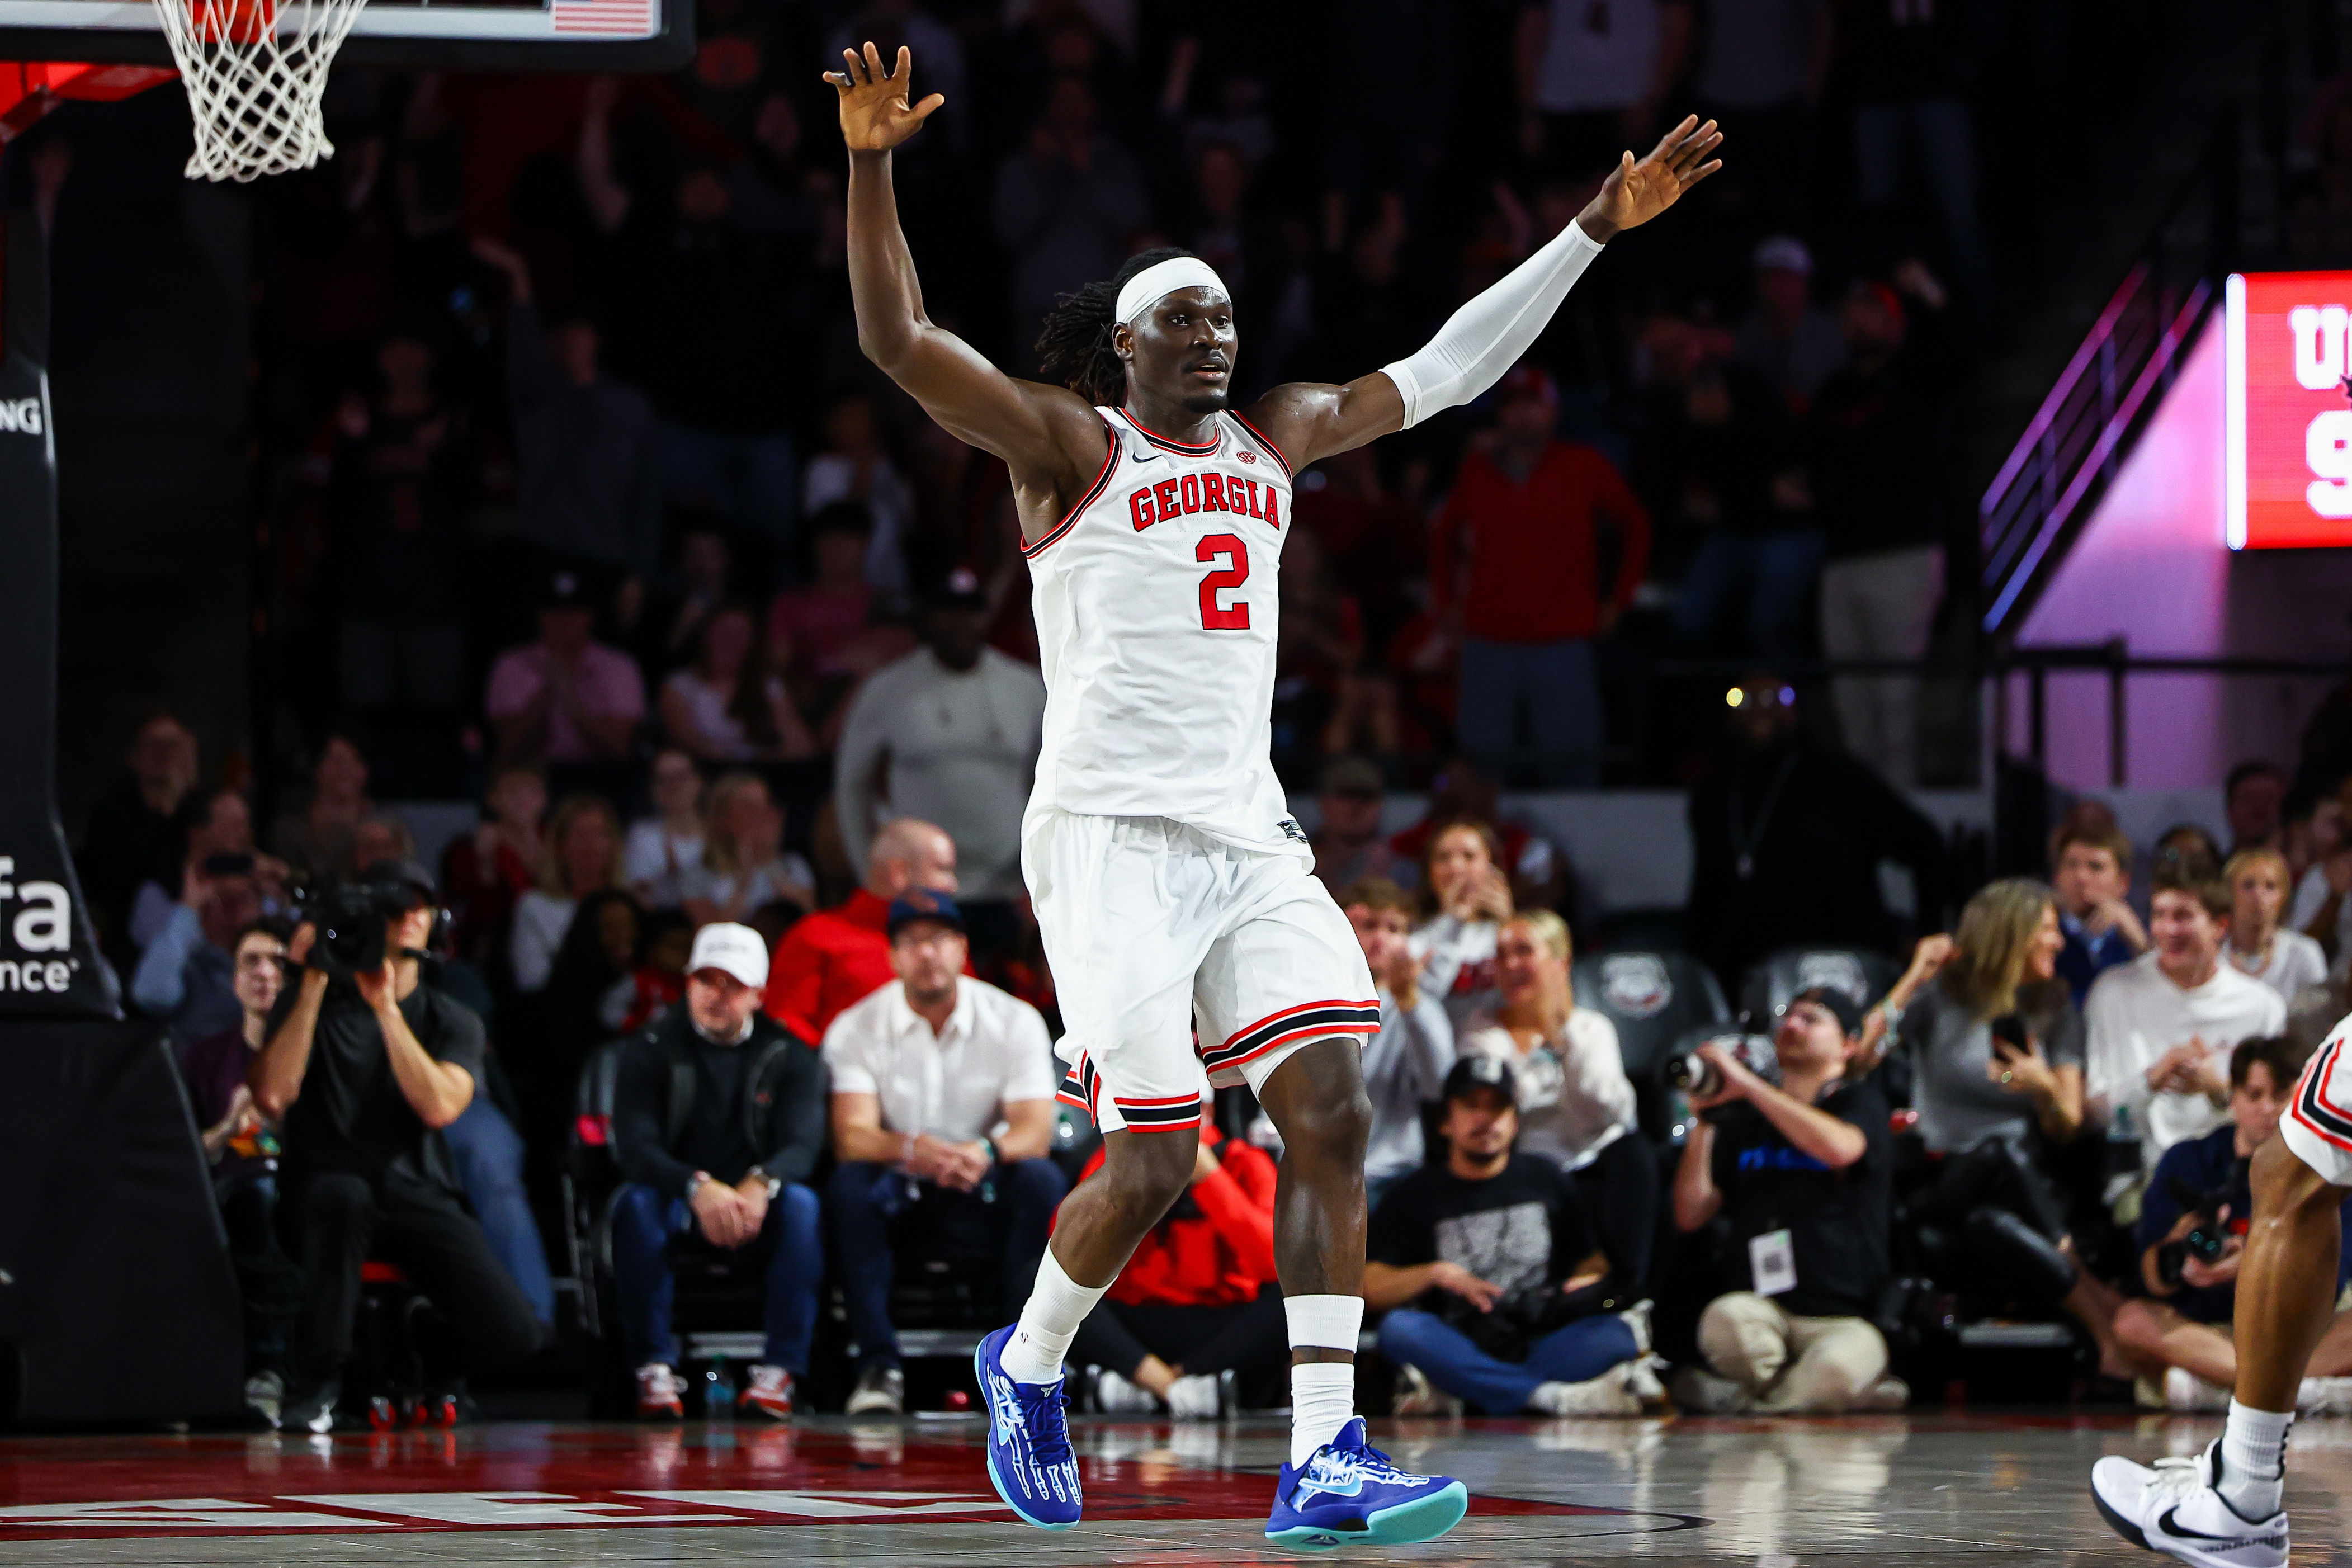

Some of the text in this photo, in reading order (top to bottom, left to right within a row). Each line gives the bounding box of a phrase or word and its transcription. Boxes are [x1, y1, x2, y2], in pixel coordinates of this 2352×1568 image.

[2287, 304, 2352, 390] U
[1237, 451, 1256, 464] SEC
[1129, 473, 1280, 532] GEORGIA
[1195, 533, 1250, 630] 2
